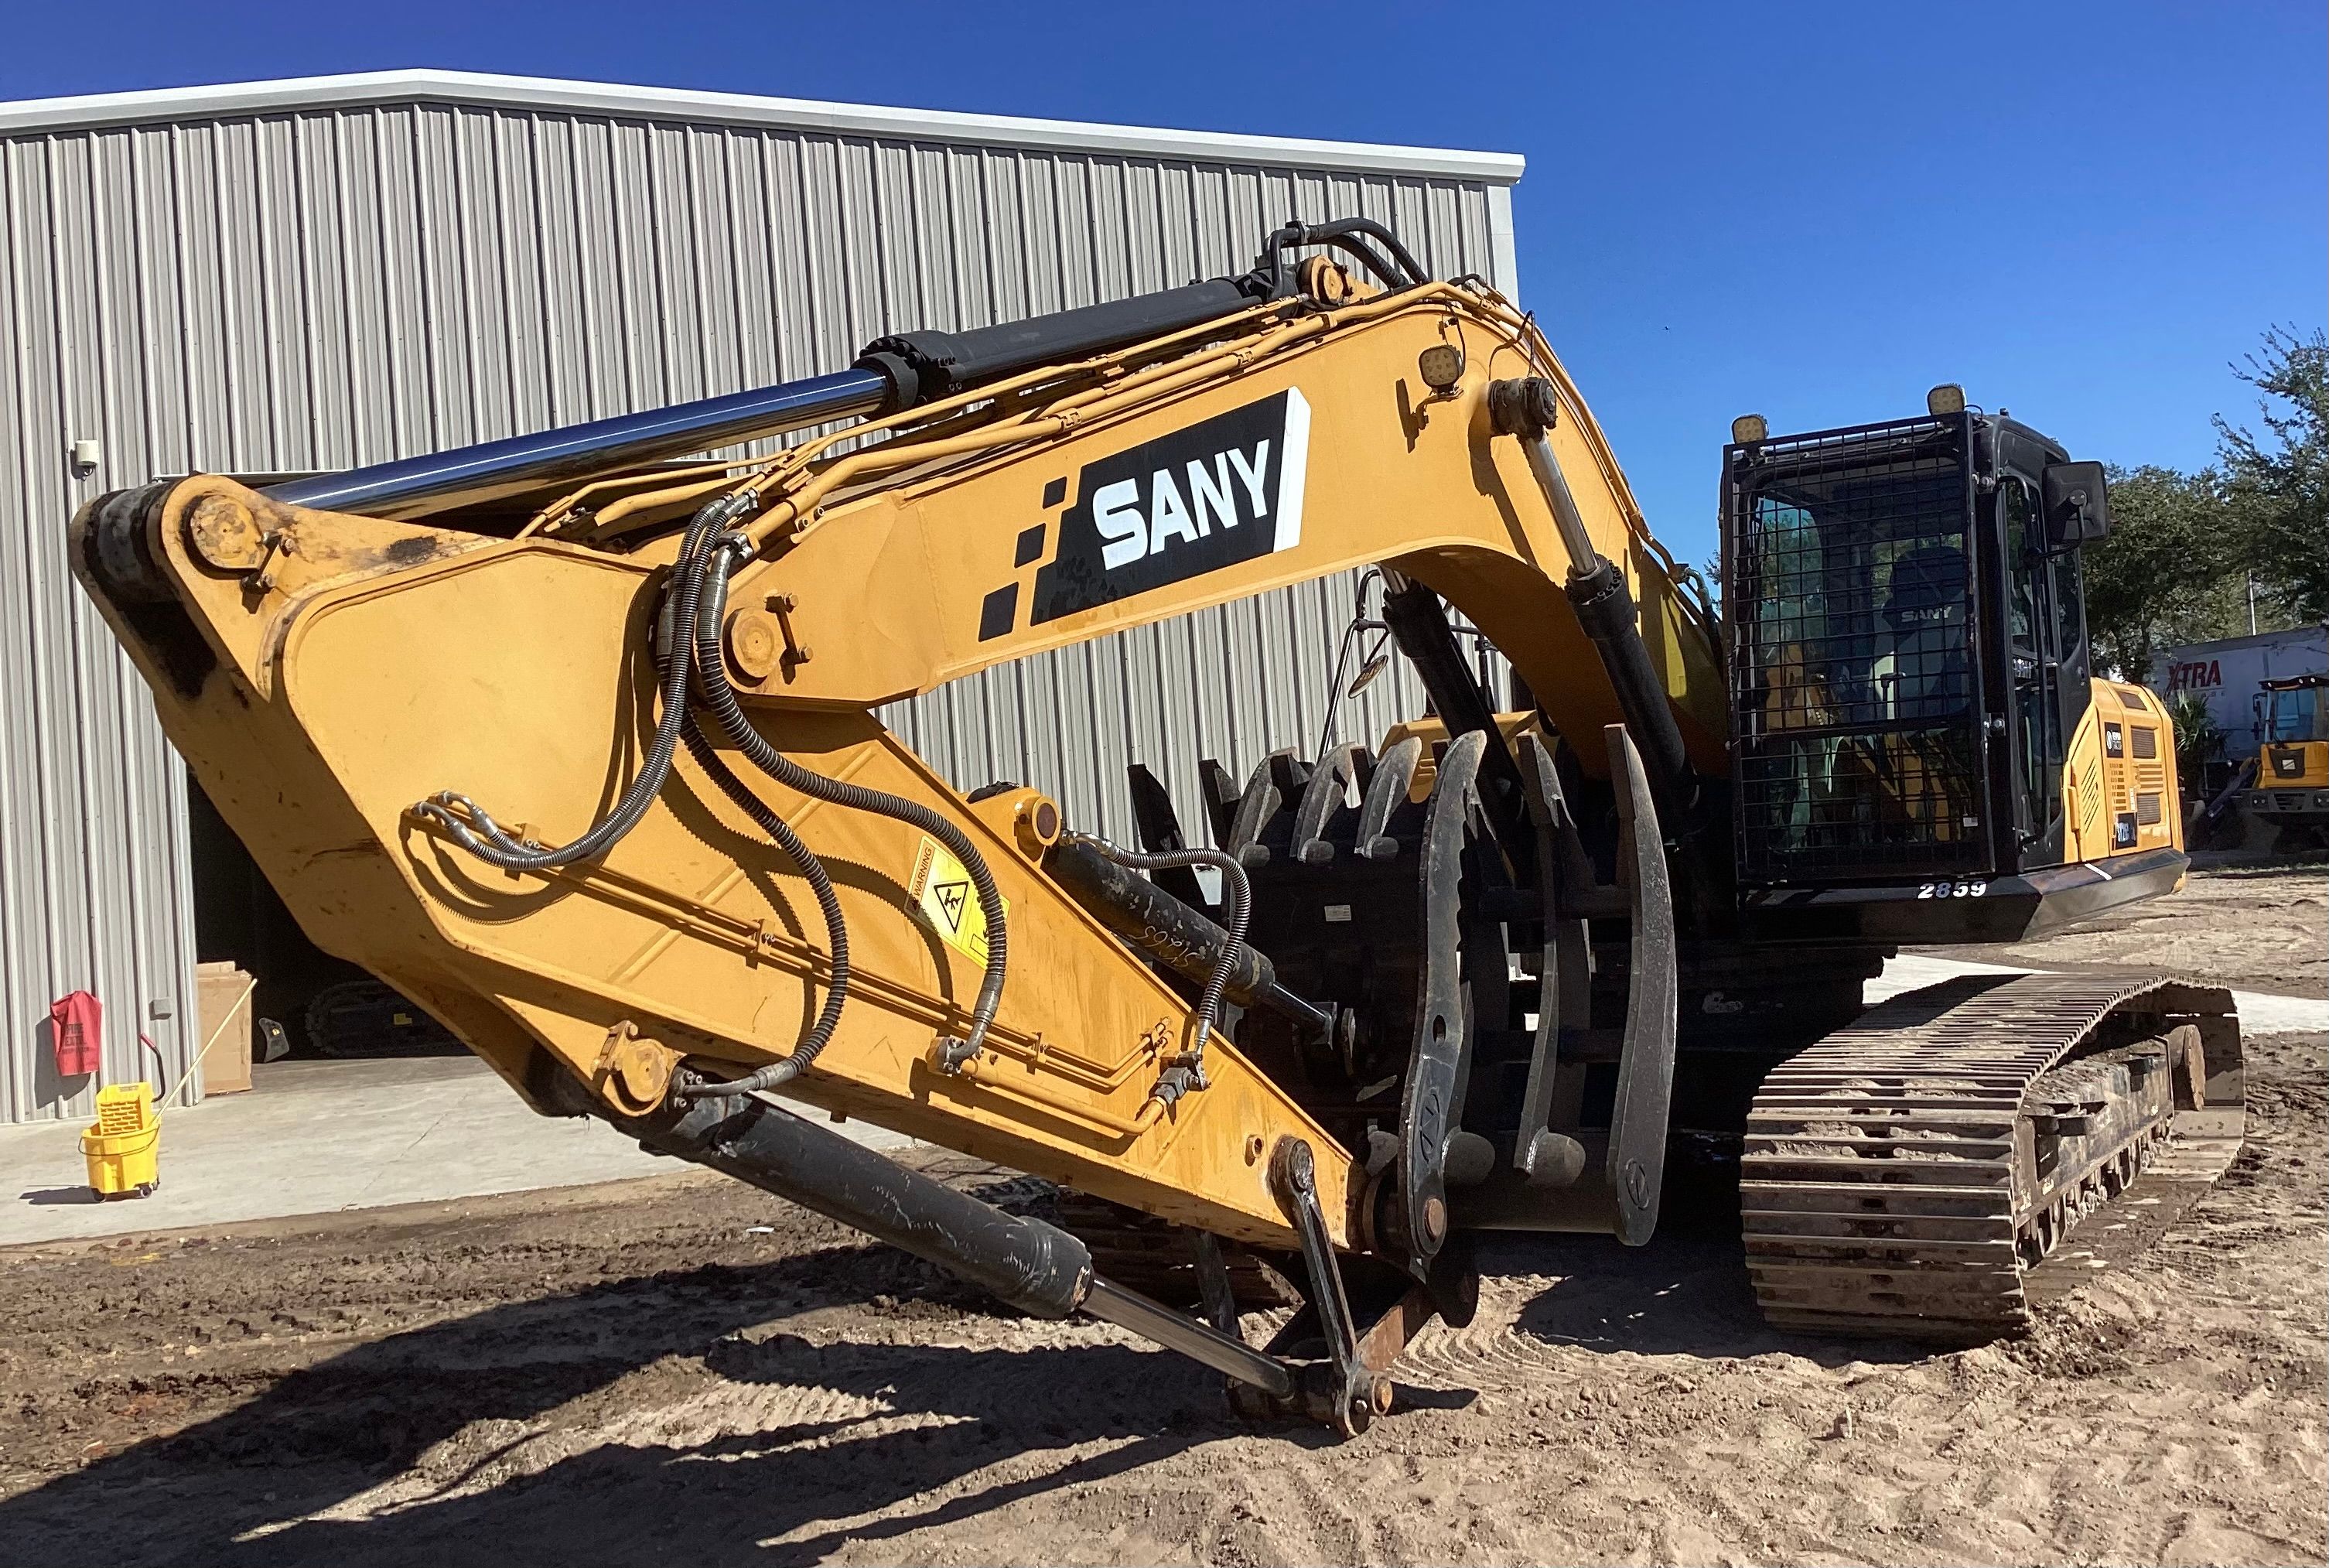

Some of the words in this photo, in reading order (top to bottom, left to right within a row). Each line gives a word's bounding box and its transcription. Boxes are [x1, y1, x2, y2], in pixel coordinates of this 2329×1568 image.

[1092, 439, 1270, 571] SANY
[1901, 606, 1952, 623] SANY
[2164, 660, 2221, 699] XTRA
[914, 846, 932, 897] WARNING
[1917, 880, 1987, 900] 2859
